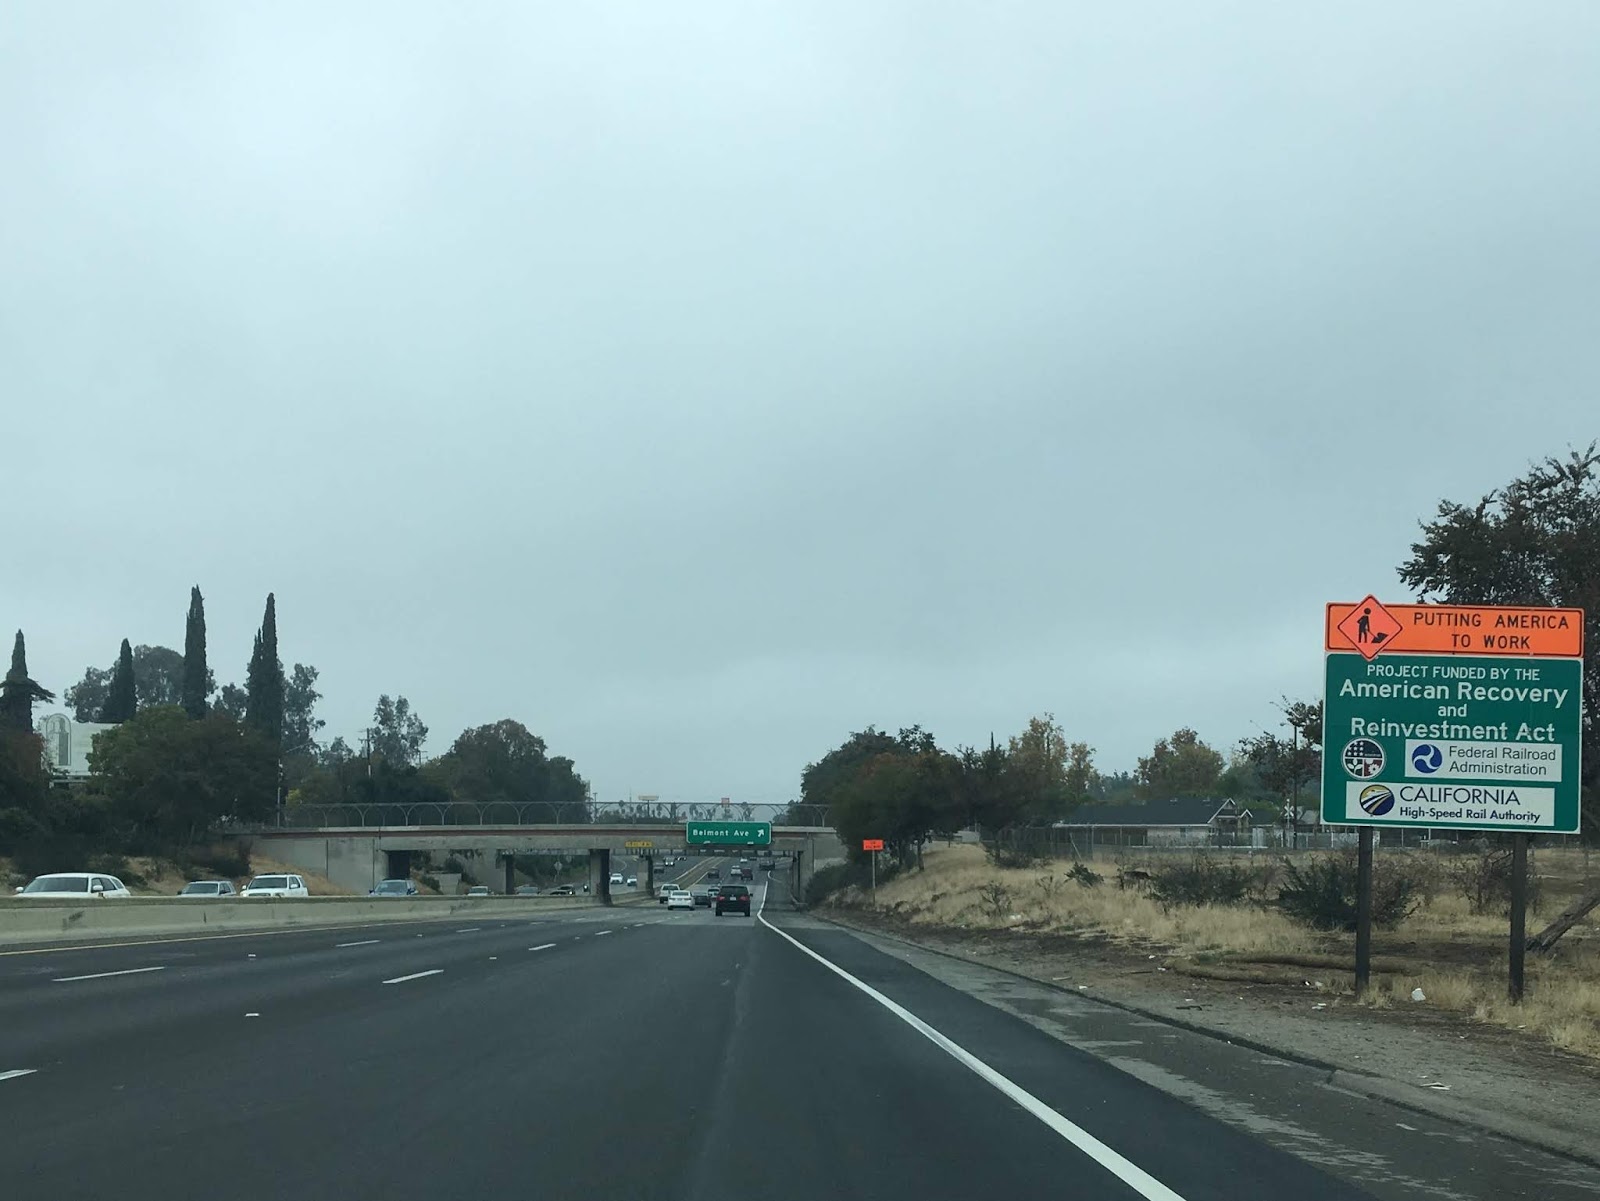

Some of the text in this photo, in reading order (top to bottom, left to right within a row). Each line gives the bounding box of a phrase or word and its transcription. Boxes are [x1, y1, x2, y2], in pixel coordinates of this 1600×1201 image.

[1413, 612, 1569, 629] PUTTING AMERICA
[1451, 633, 1530, 650] TO WORK
[1366, 664, 1541, 682] PROJECT FUNDED BY THE
[1339, 678, 1569, 709] American Recovery
[1437, 703, 1468, 718] and
[1350, 717, 1555, 743] Reinvestment Act
[1448, 746, 1557, 762] Federal Railroad
[1448, 761, 1547, 776] Administration
[1399, 786, 1521, 806] CALIFORNIA
[1399, 806, 1541, 824] High-Speed Rail Authority
[692, 828, 750, 837] Belmont Ave
